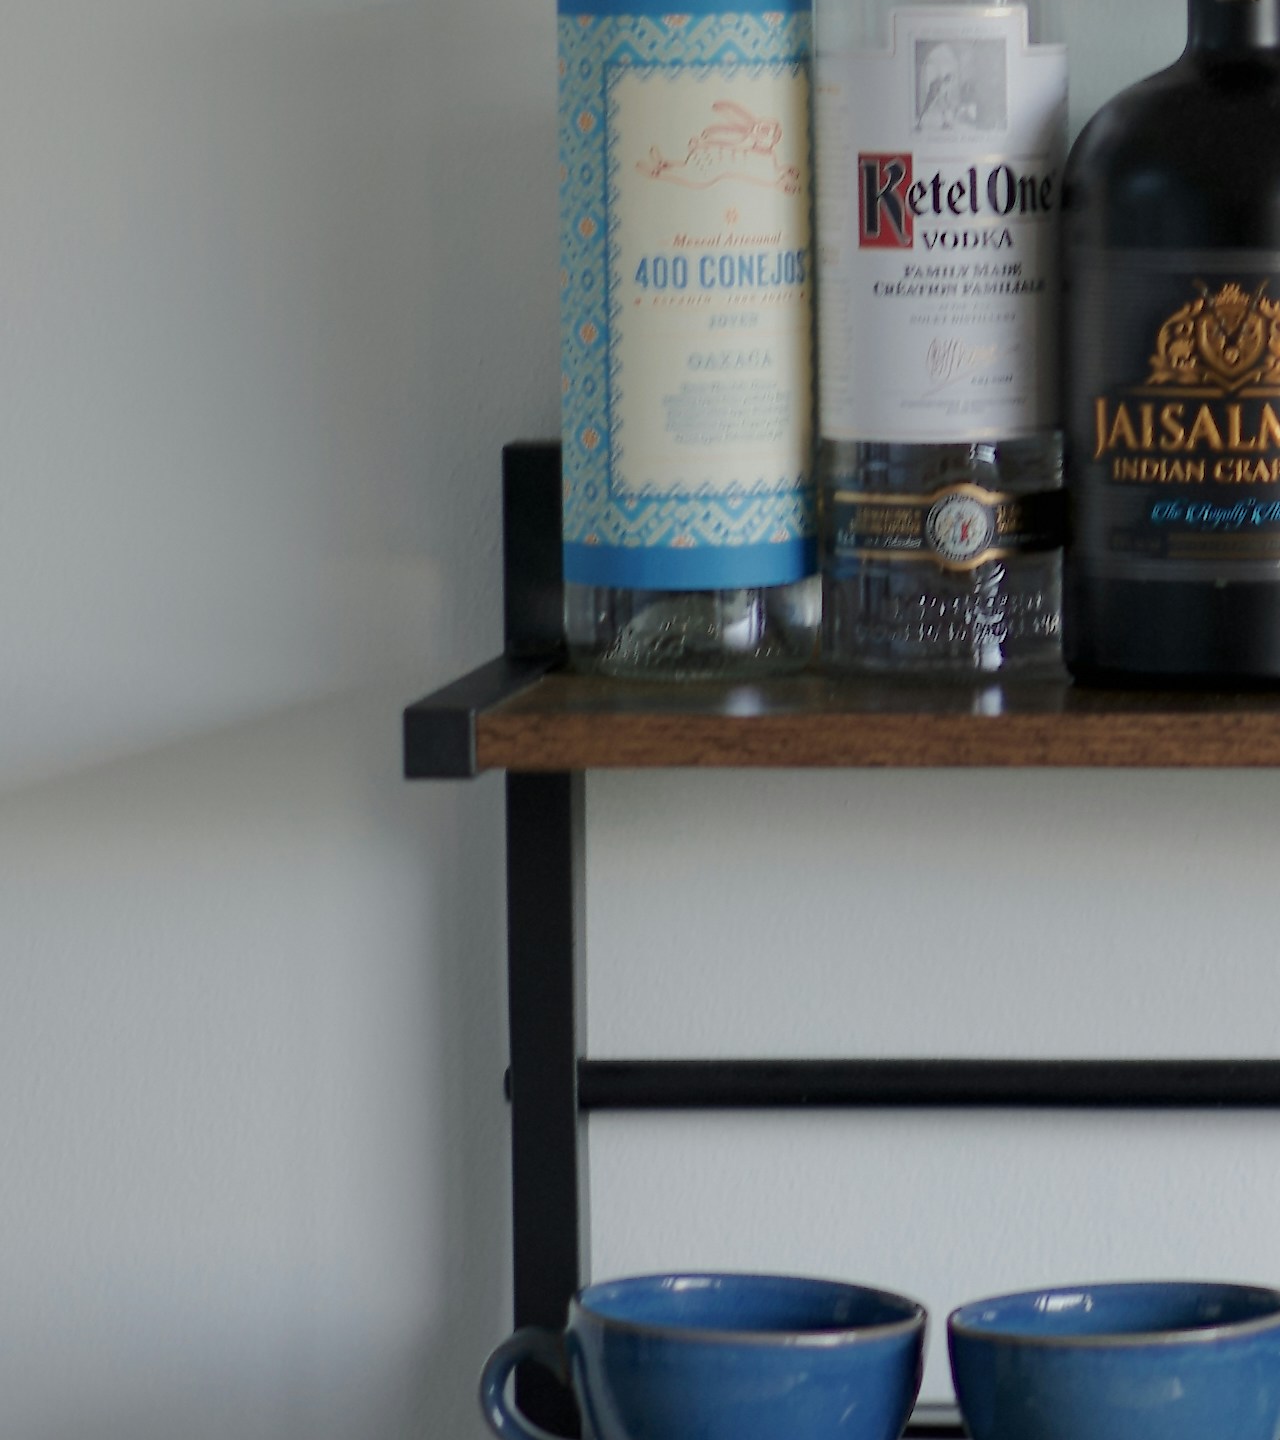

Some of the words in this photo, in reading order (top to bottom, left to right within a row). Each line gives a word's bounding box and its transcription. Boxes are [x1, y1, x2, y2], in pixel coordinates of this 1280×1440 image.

[861, 159, 981, 246] Ketel
[988, 165, 1050, 215] One
[923, 228, 1013, 249] VODKA
[635, 256, 688, 290] 400
[699, 250, 806, 289] CONEJOS
[688, 350, 772, 370] OAXACA
[1112, 456, 1206, 482] INDIAN
